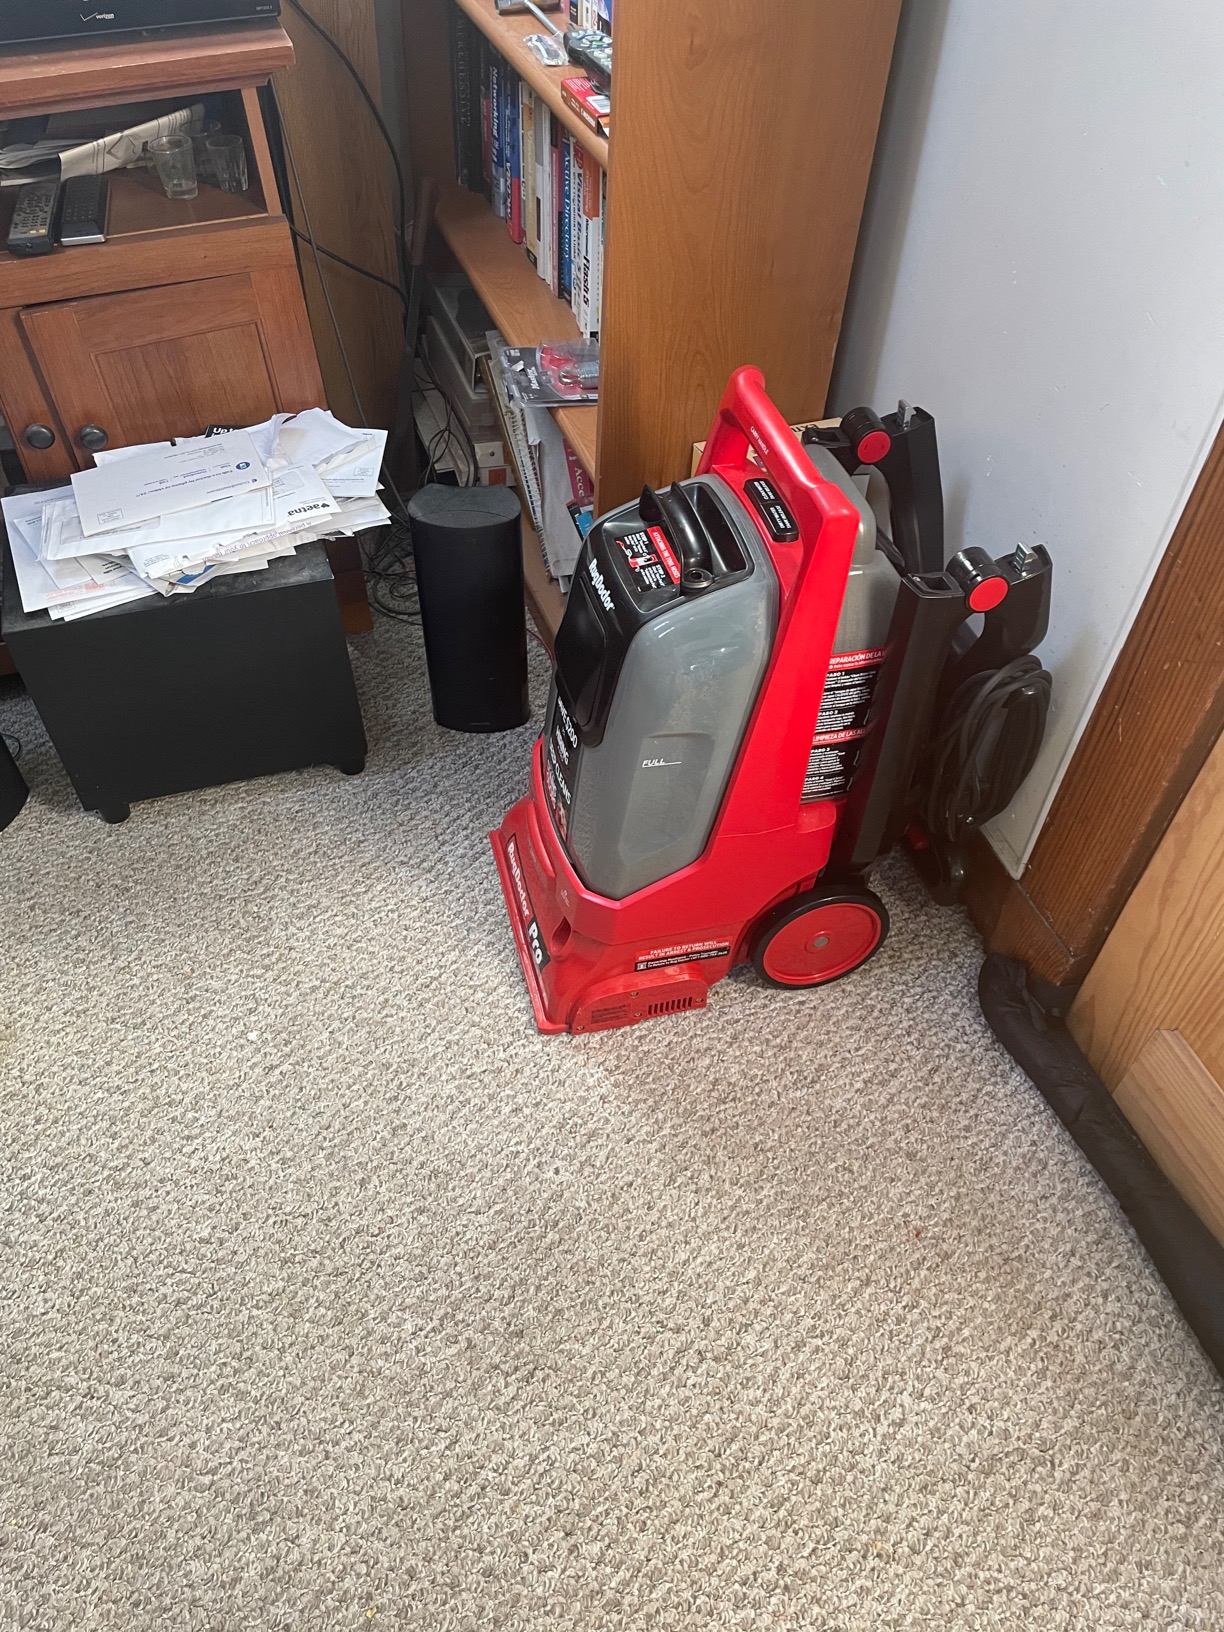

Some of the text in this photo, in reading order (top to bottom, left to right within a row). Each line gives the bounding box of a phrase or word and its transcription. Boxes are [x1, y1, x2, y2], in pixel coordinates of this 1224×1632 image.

[491, 67, 499, 138] Networking
[564, 151, 572, 265] Active Directory
[582, 256, 590, 294] Flash
[582, 295, 590, 306] 5
[750, 426, 769, 455] CARRY HANDLE
[288, 502, 320, 517] aetna
[246, 532, 277, 547] approach
[639, 532, 648, 543] STEP
[223, 544, 239, 555] your
[656, 564, 664, 576] STEP
[588, 558, 616, 611] RugDoctor
[564, 716, 578, 748] $200
[812, 733, 838, 742] LIMPIEZA
[642, 759, 665, 768] FULL
[556, 762, 572, 805] CLEANS
[508, 842, 542, 964] RugDoctor Pro
[692, 942, 730, 951] PROSECUTION
